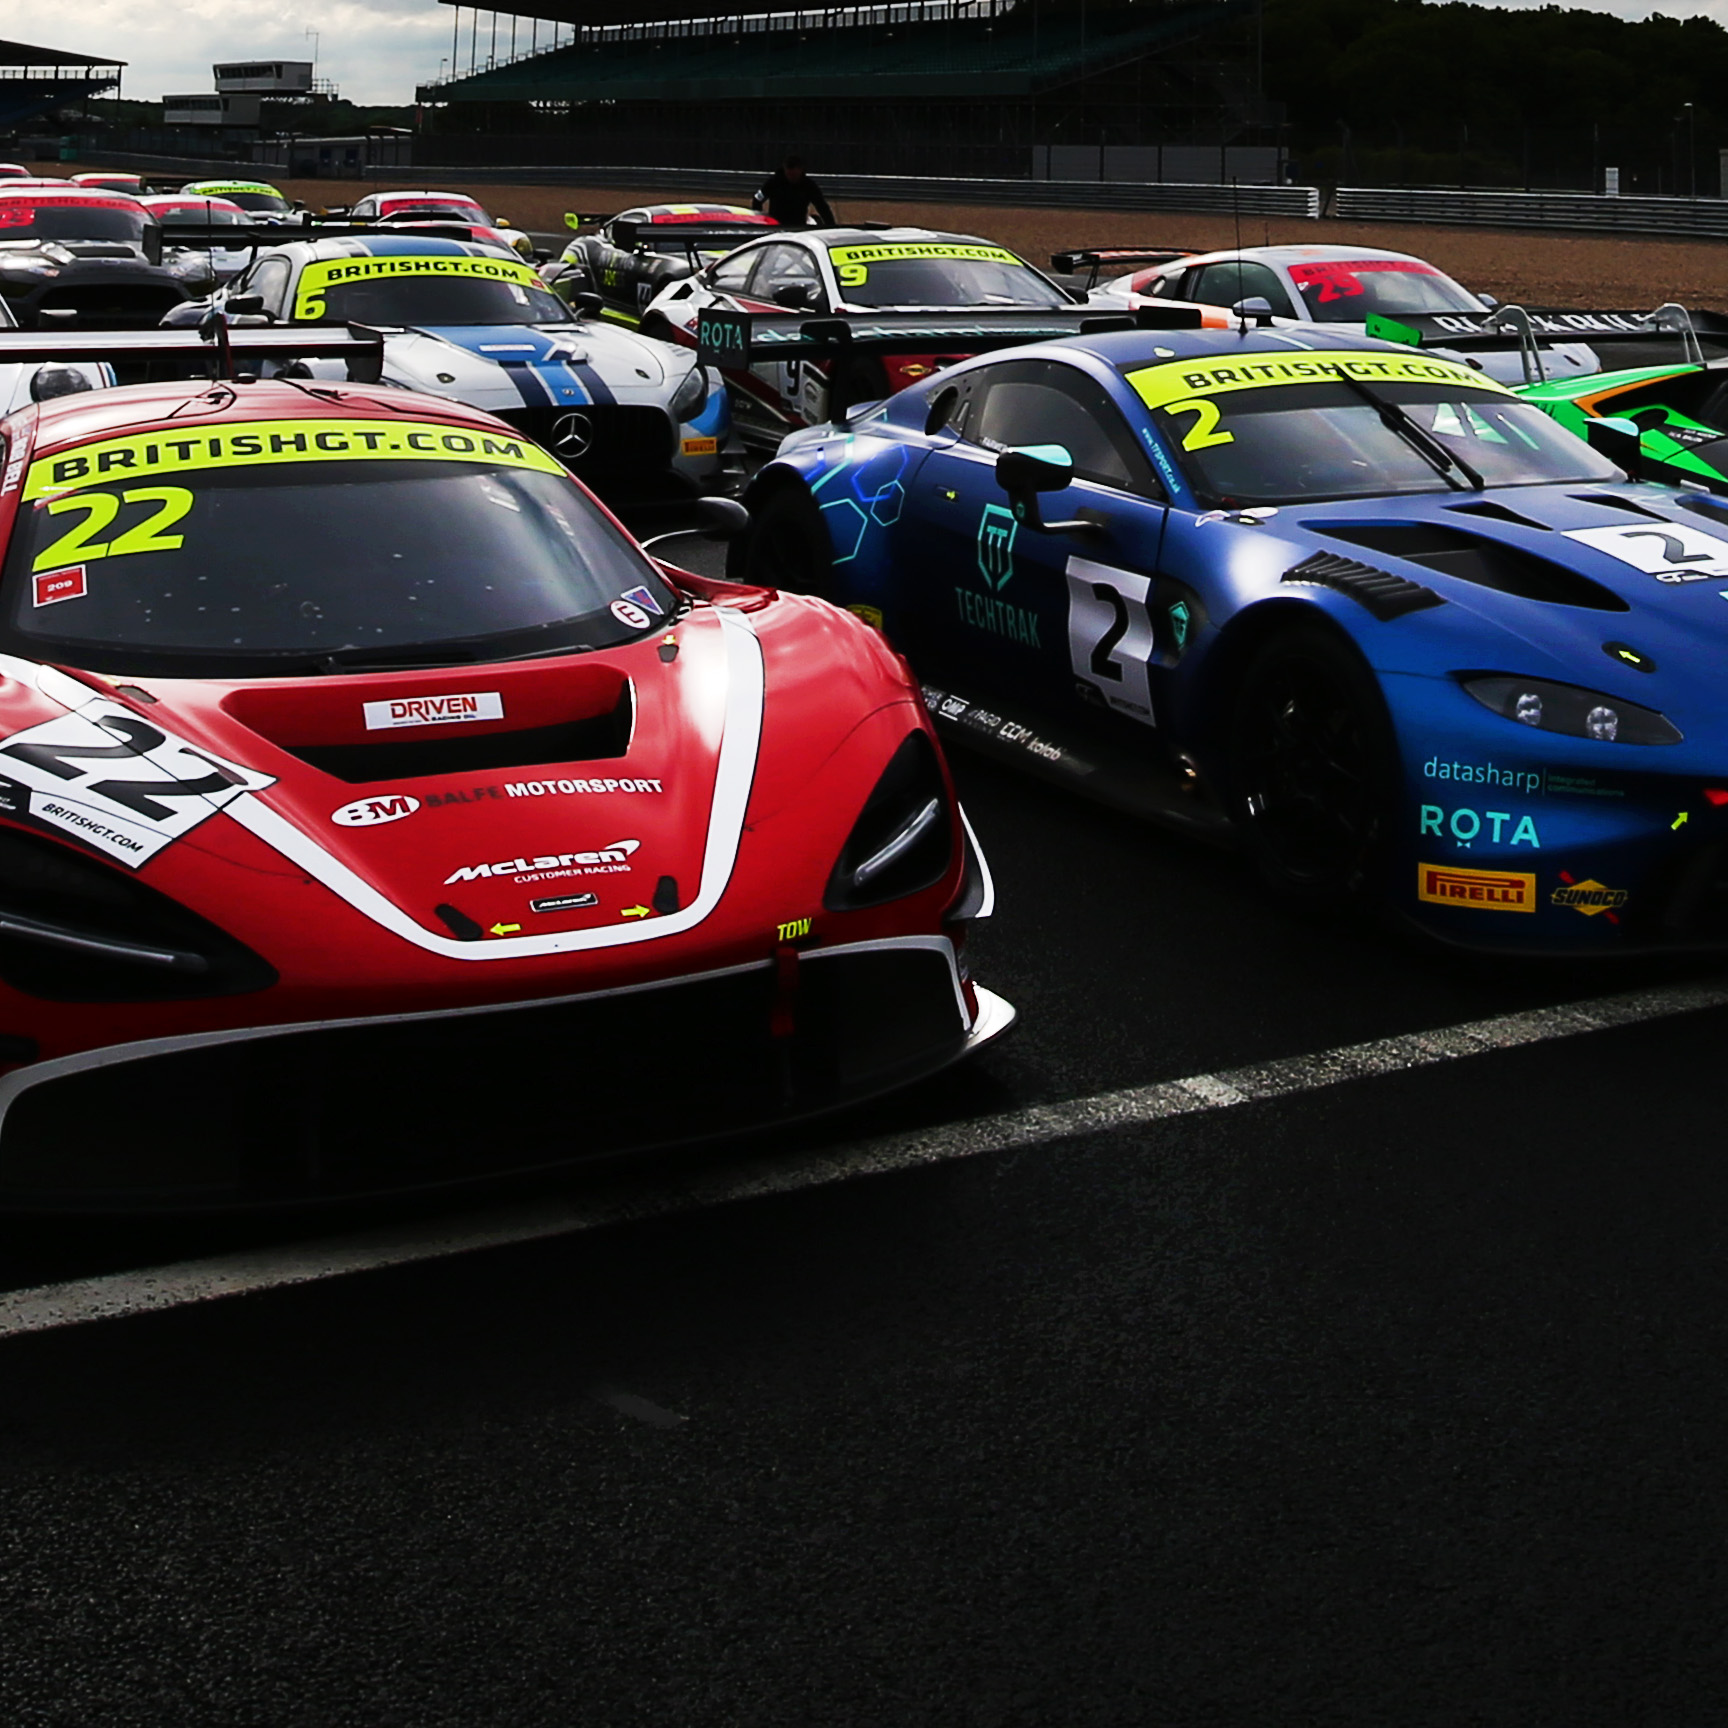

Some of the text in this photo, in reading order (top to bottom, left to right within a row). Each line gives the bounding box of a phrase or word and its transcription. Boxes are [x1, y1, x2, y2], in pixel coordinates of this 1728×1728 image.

[845, 245, 1007, 262] BRITISHGT.COM
[327, 261, 520, 282] BRITISHGT.COM
[839, 263, 869, 287] 9
[294, 289, 327, 320] 6
[700, 320, 744, 352] ROTA
[1182, 360, 1484, 390] BRITISHGT.COM
[1163, 398, 1235, 453] 2
[52, 431, 524, 485] BRITISHGT.COM
[0, 460, 24, 497] BELL
[31, 485, 195, 573] 22
[1623, 530, 1714, 564] 2
[47, 579, 73, 593] 209
[954, 585, 1042, 649] TECHTRAK
[1090, 582, 1129, 683] 2
[390, 696, 478, 722] DRIVEN
[940, 698, 967, 717] OMP
[998, 721, 1033, 745] CCM
[1423, 756, 1541, 795] datasharp
[425, 778, 665, 807] BALFE MOTORSPORT
[41, 802, 144, 854] BRITISHGT.COM
[1420, 804, 1541, 849] ROTA
[443, 844, 632, 885] McLaren
[513, 863, 632, 884] CUSTOMER RACING
[1426, 870, 1526, 904] PIRELLI
[1552, 888, 1627, 908] SUNOCO
[776, 917, 813, 942] TOW
